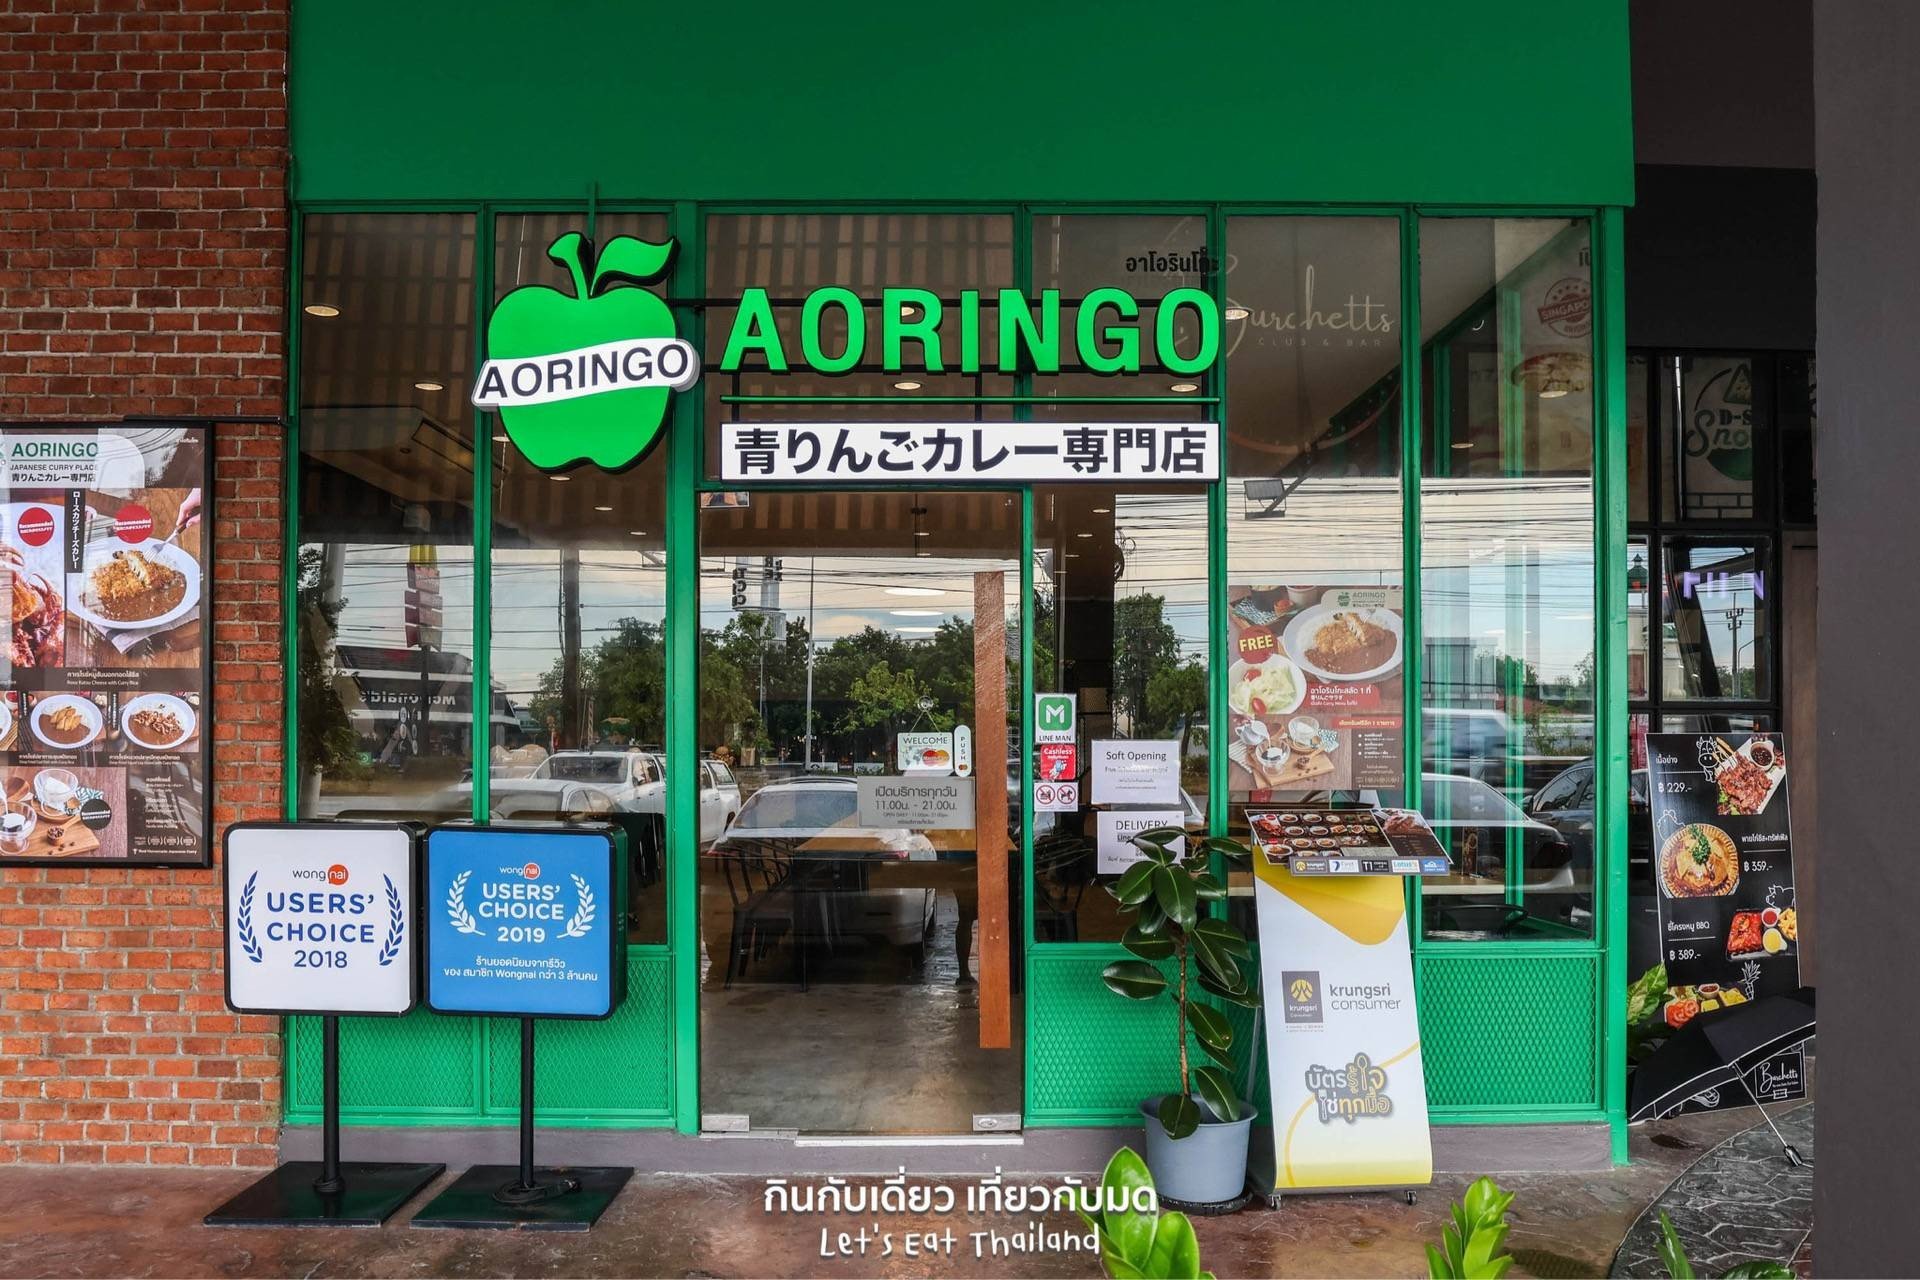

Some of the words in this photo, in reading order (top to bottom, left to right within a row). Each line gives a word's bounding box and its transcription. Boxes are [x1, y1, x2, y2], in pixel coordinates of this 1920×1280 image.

[719, 286, 1221, 375] AORINGO
[478, 344, 688, 400] AORINGO
[734, 426, 1207, 475] 青りんごカレー専門店
[1239, 634, 1274, 652] FREE
[903, 737, 948, 745] WELCOME
[1106, 751, 1125, 760] Soft
[1127, 751, 1167, 761] Opening
[875, 786, 957, 800] เปิดบริการทุกวัน
[875, 800, 910, 810] 11.00น.
[922, 800, 957, 810] 21.00น.
[478, 901, 565, 921] CHOICE
[266, 922, 375, 943] CHOICE
[1696, 920, 1710, 930] BBQ
[497, 926, 546, 944] 2019
[293, 949, 348, 969] 2018
[475, 955, 566, 968] ร้านยอดนิยมจากรีวิว
[443, 968, 461, 977] ของ
[463, 967, 493, 977] สมาชิก
[495, 970, 537, 981] Wongnai
[538, 970, 557, 980] กว่า
[558, 971, 565, 980] 3
[566, 970, 598, 981] ล้านคน
[1329, 983, 1391, 999] krungsri
[1289, 1004, 1318, 1012] krungsri
[1330, 998, 1402, 1010] consumer
